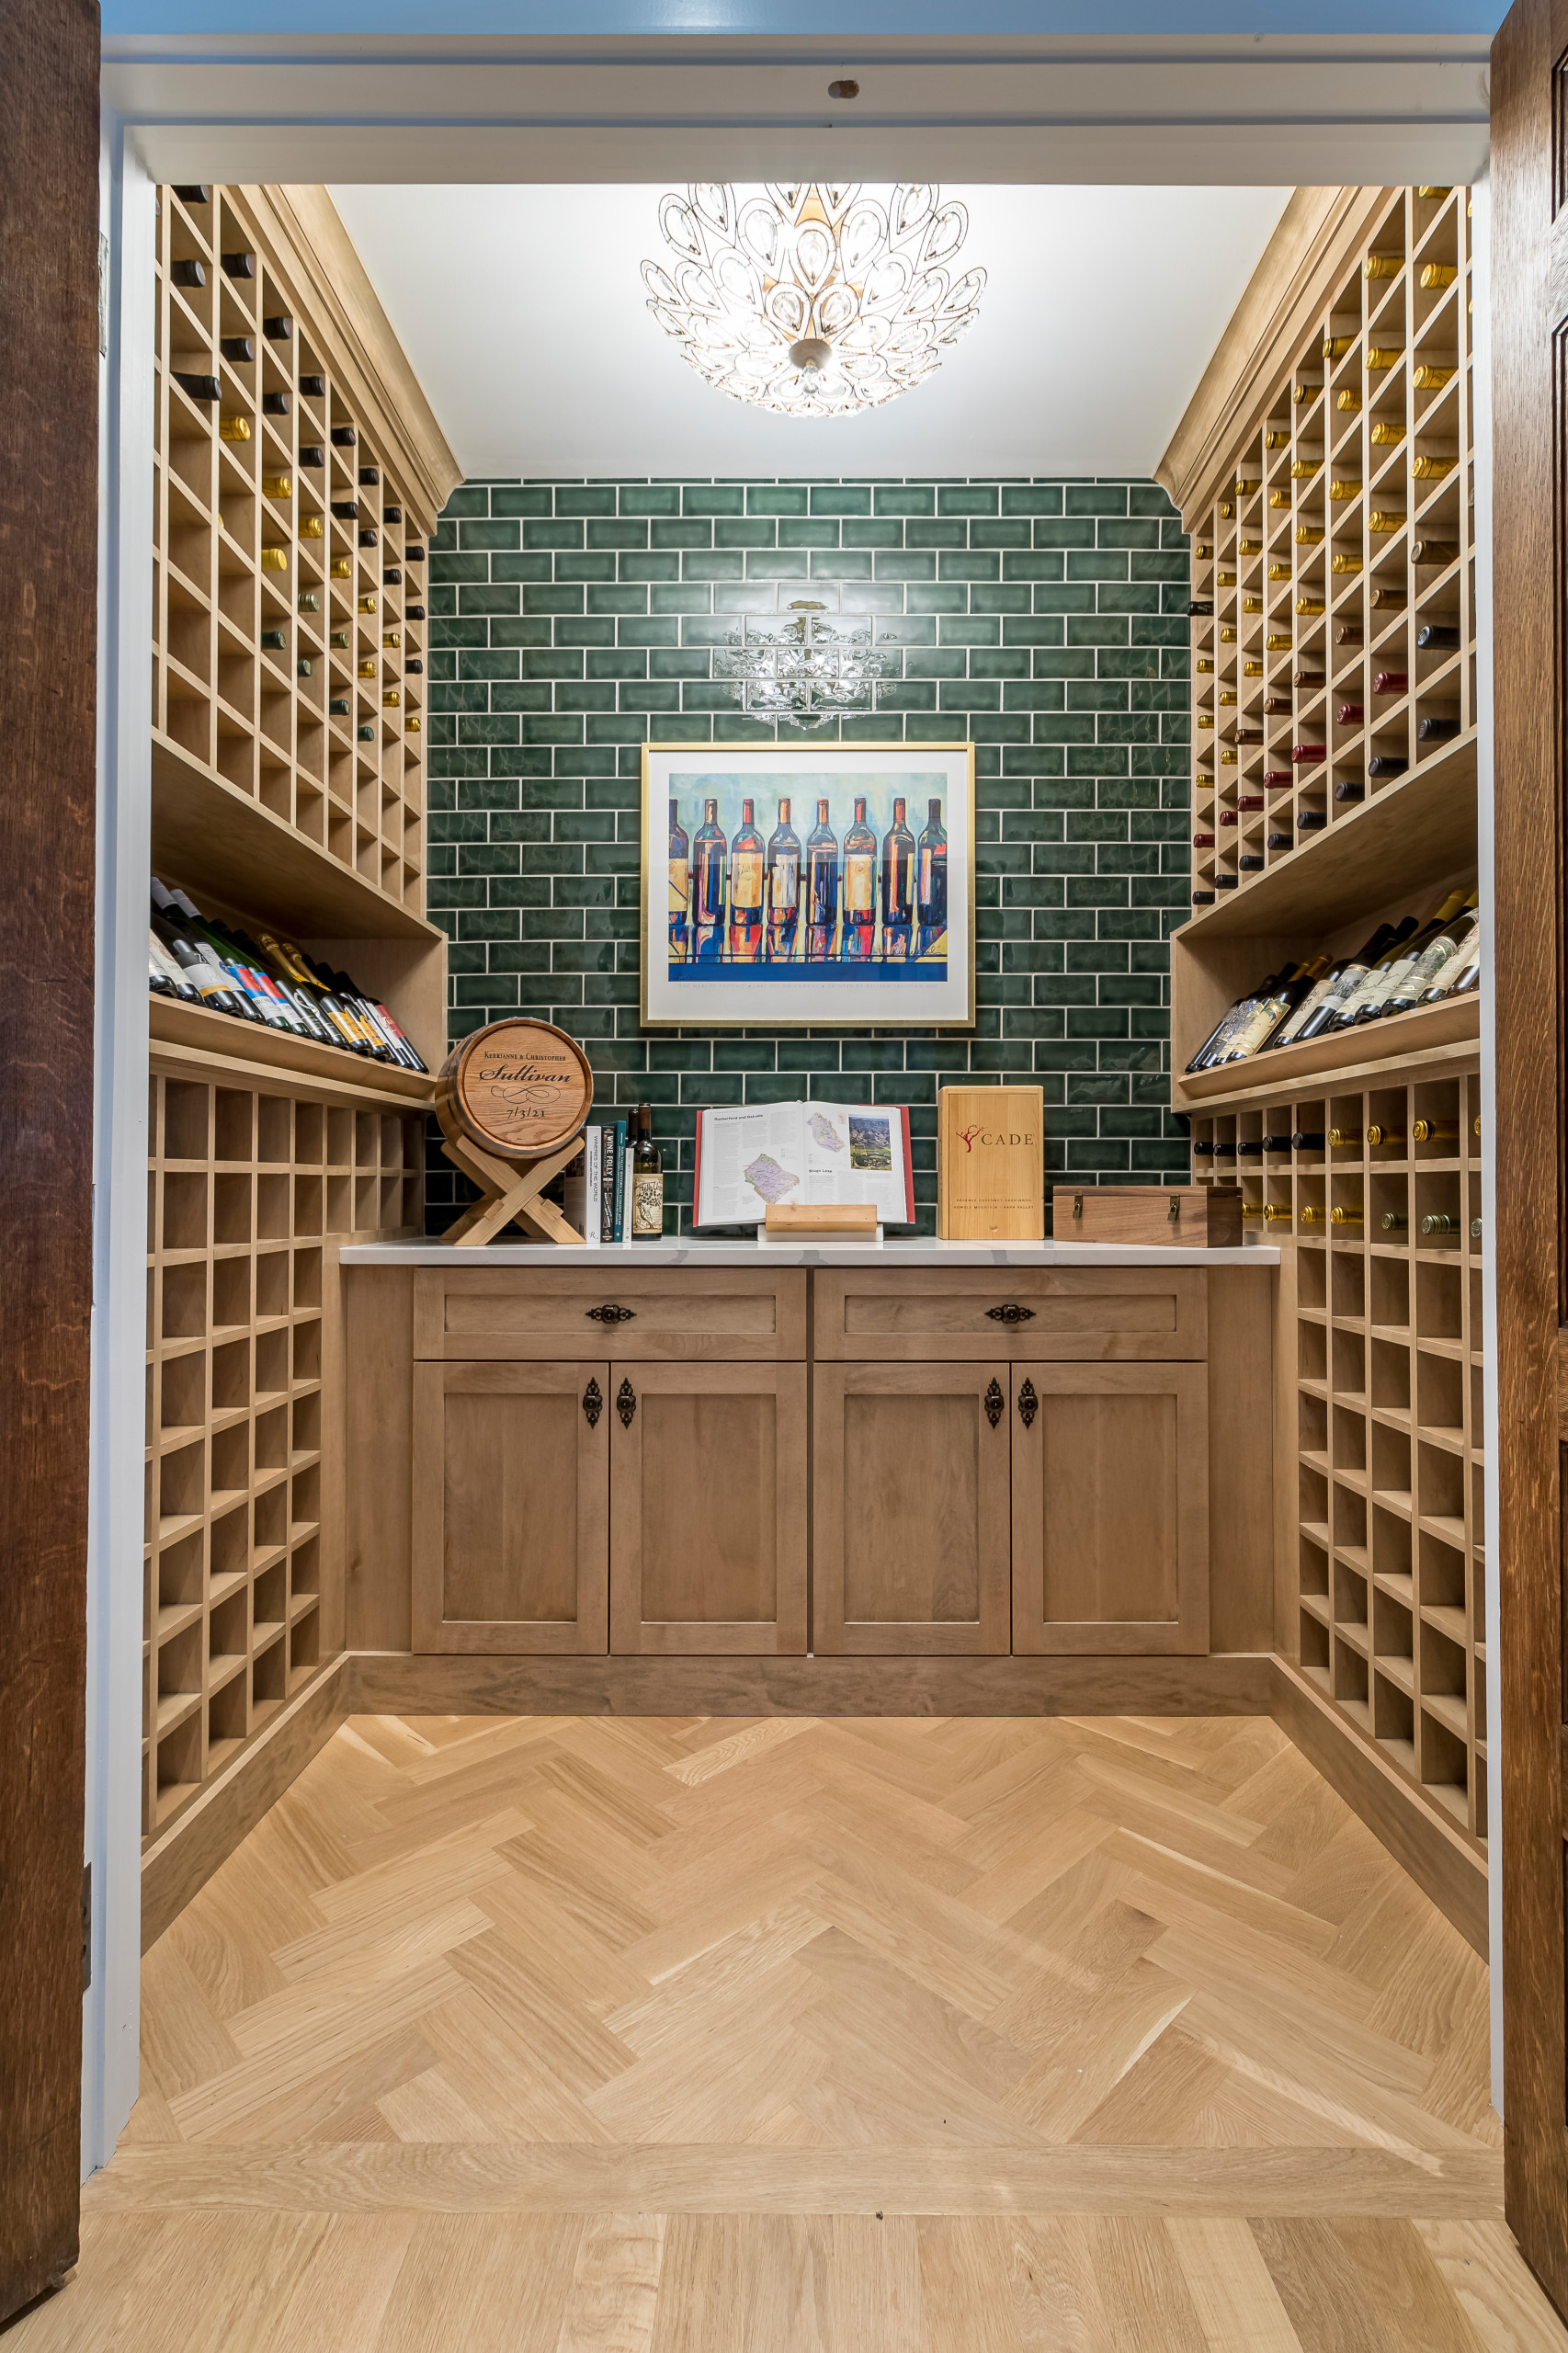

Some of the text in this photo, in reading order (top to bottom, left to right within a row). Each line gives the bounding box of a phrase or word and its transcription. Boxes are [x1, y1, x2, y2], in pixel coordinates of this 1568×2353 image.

[479, 1063, 572, 1083] Sullivan
[506, 1107, 546, 1120] 7/3/21
[606, 1135, 614, 1154] WINE
[981, 1133, 1034, 1146] CADE
[606, 1155, 614, 1176] FOLLY
